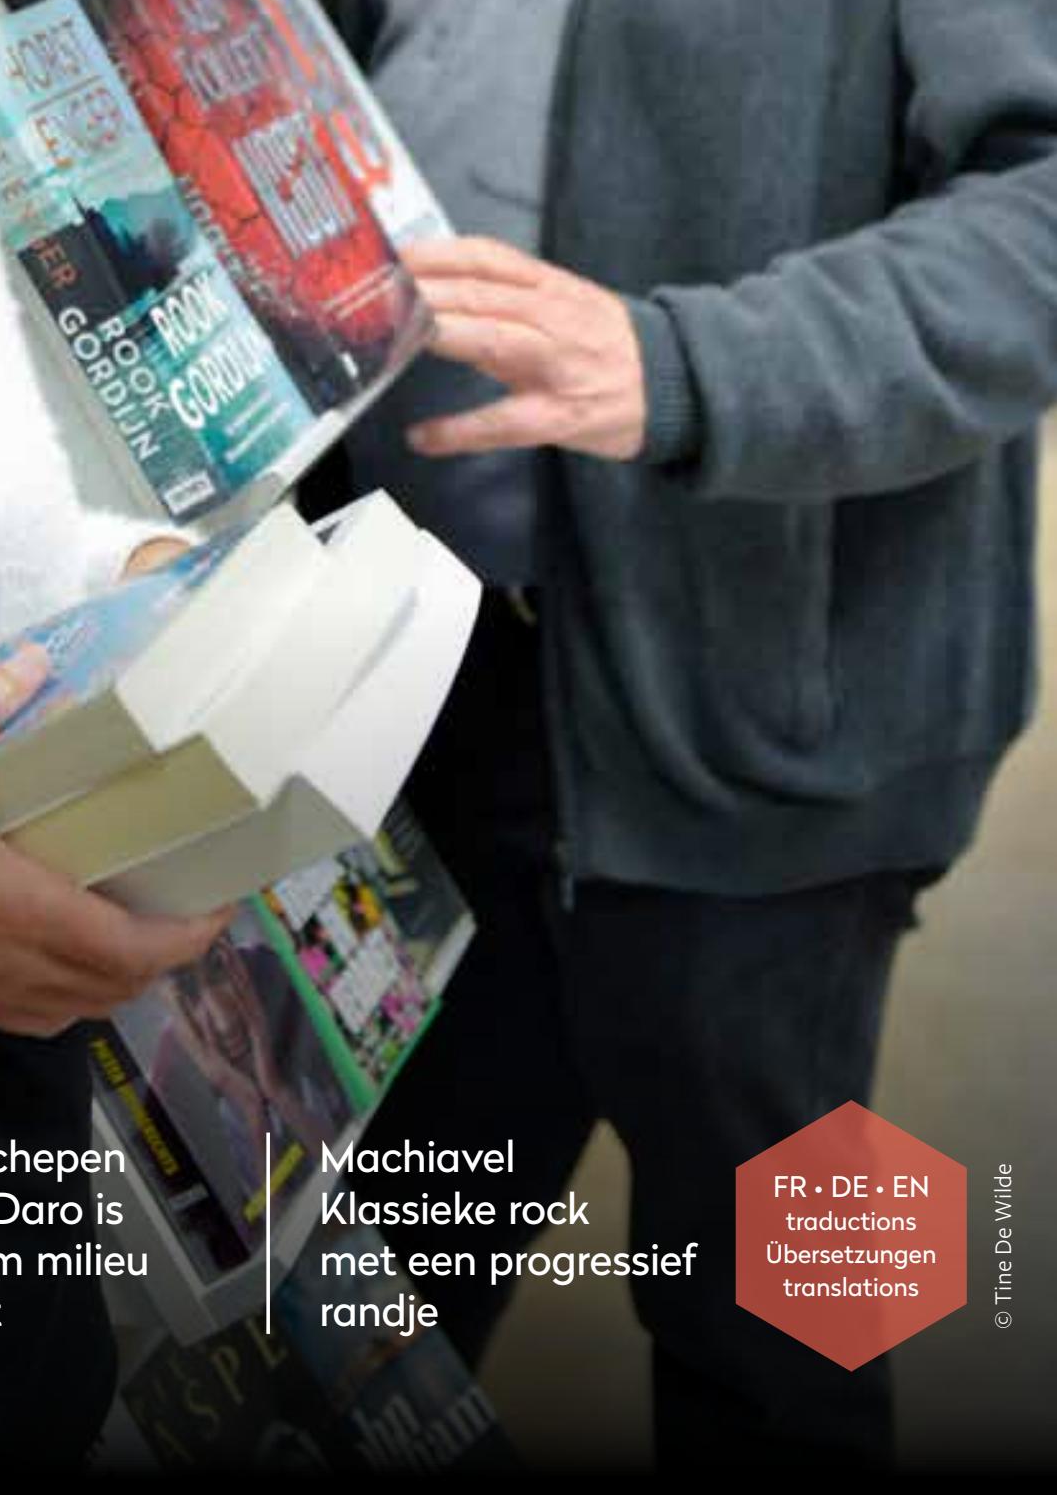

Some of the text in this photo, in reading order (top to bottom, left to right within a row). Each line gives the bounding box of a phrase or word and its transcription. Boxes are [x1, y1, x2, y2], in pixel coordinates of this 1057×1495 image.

[150, 271, 231, 359] ROOK
[58, 307, 162, 461] GORDIJN
[98, 316, 172, 421] ROOK
